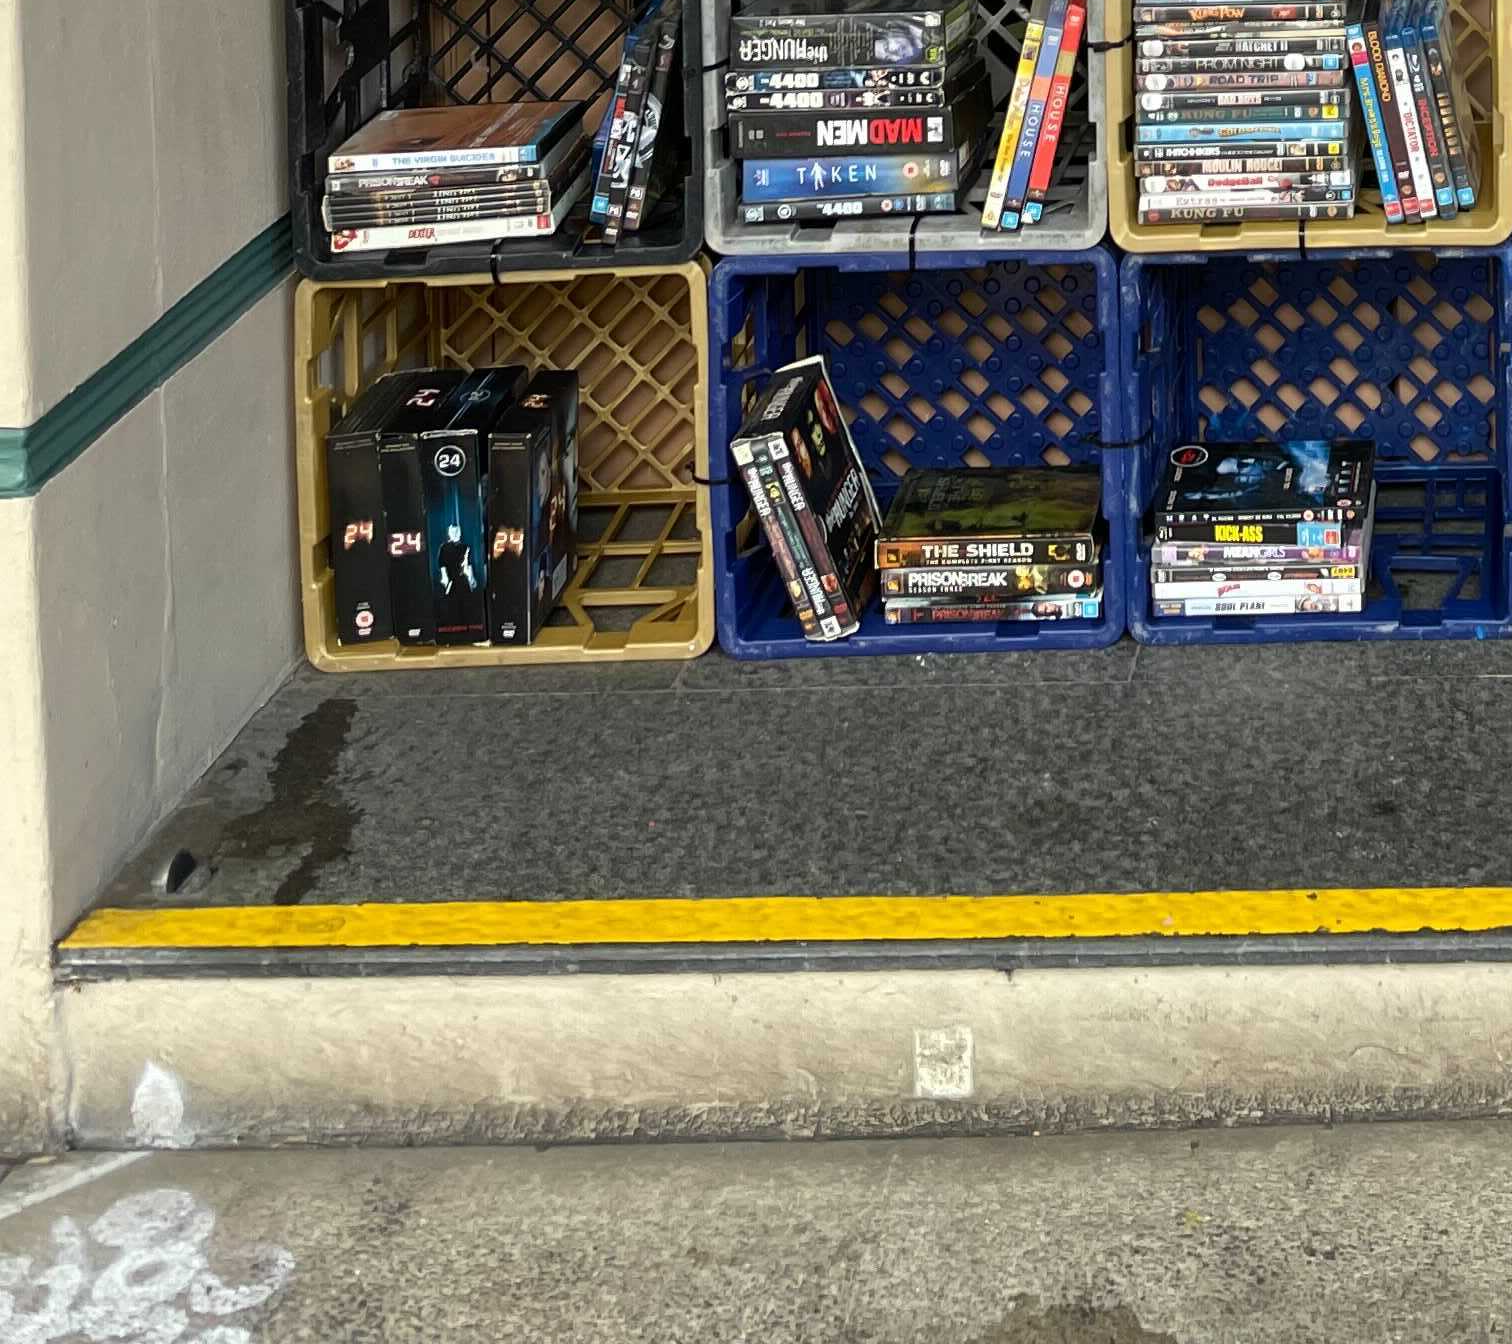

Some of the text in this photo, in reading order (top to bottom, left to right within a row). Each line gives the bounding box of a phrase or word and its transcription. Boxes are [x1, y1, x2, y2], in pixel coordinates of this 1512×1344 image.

[738, 38, 807, 61] HUNGER
[1366, 30, 1382, 67] BLOOD
[768, 72, 820, 89] 4400
[1208, 74, 1279, 85] ROAD TRIP
[770, 92, 823, 108] 4400
[1043, 84, 1066, 144] HOUSE
[816, 117, 923, 146] MAD MEN
[1019, 102, 1043, 159] HOUSE
[1417, 97, 1439, 158] INCEPTION
[413, 155, 448, 164] VIRGIN
[822, 200, 863, 215] 4400
[1170, 207, 1217, 219] KUNG
[438, 453, 461, 468] 24
[344, 521, 374, 546] 24
[493, 531, 524, 556] 24
[1214, 524, 1264, 544] KICK-ASS
[390, 532, 422, 557] 24
[921, 542, 1034, 559] THE SHIELD
